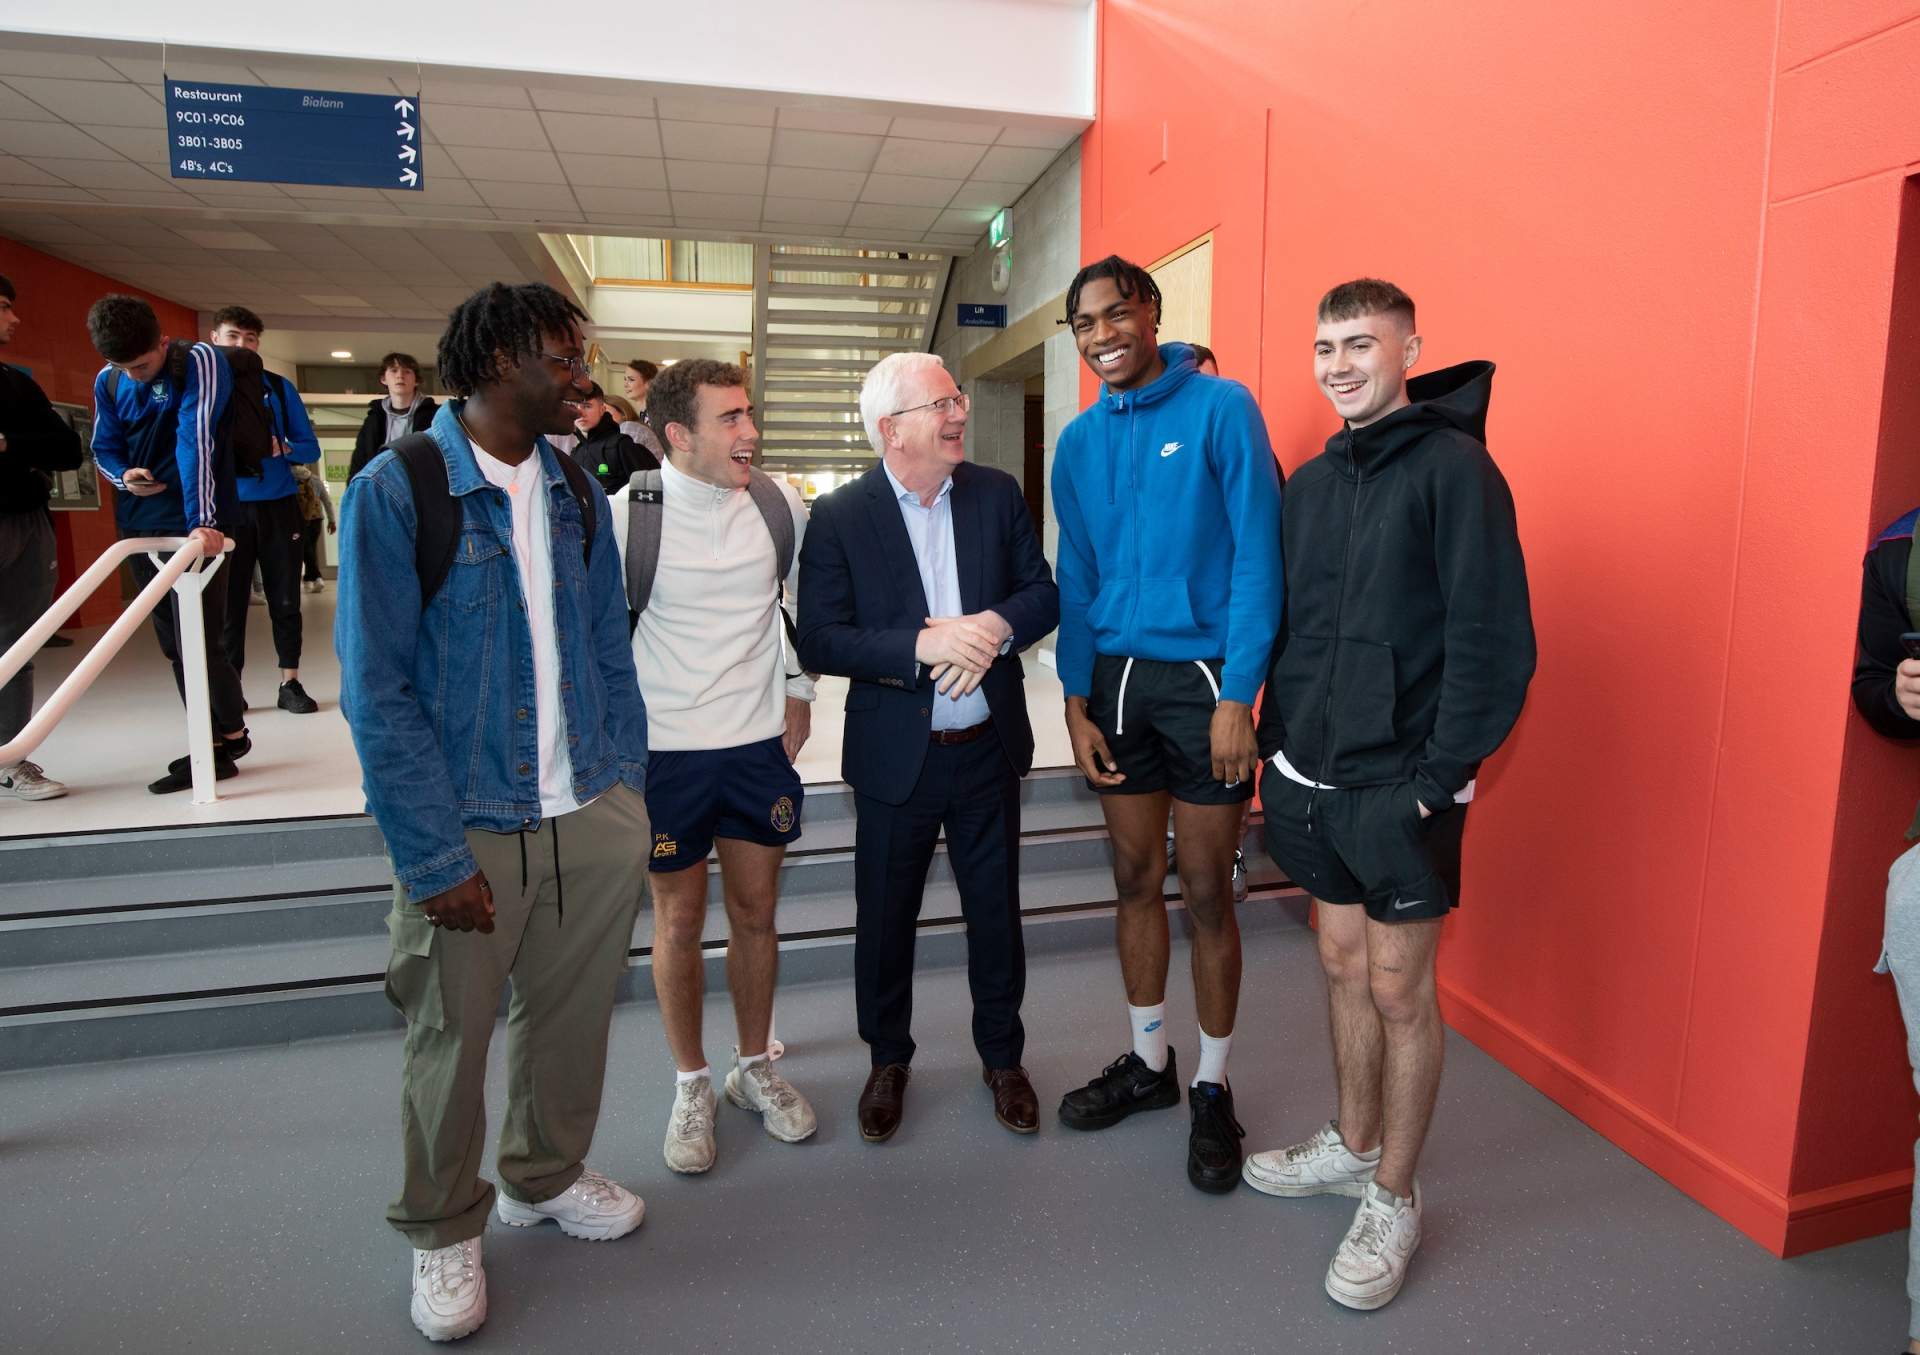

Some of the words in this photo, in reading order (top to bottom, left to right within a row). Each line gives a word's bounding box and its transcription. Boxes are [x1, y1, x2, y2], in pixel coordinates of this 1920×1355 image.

[174, 86, 242, 103] Restaurant
[302, 95, 344, 109] Bialann
[176, 111, 245, 127] 9C01-9C06
[178, 135, 243, 150] 3B01-3B05
[180, 160, 206, 174] 4B's,
[209, 161, 234, 173] 4C's
[974, 306, 985, 314] Lift
